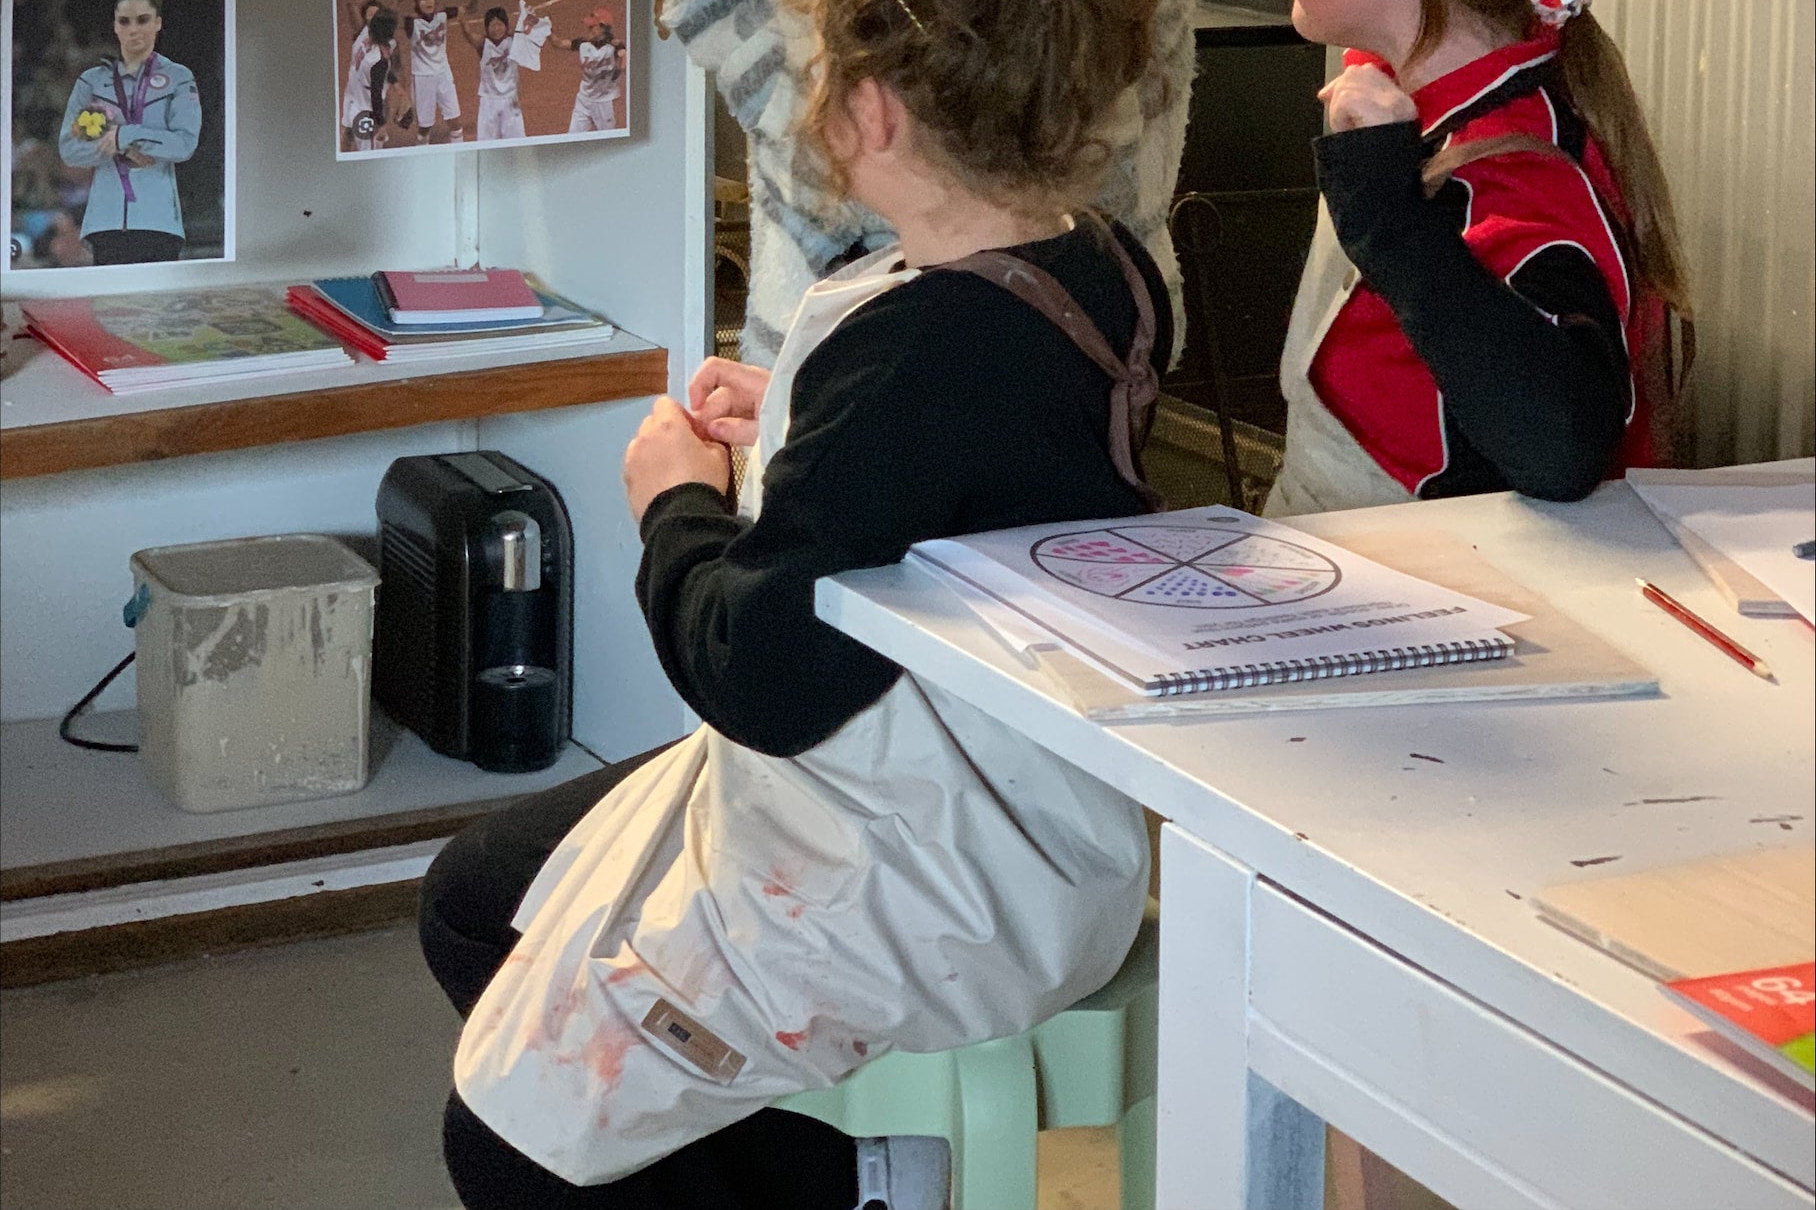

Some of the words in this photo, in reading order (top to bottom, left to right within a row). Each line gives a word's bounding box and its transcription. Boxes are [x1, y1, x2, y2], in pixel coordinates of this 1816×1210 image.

[1352, 606, 1468, 629] FEELINGS
[1266, 623, 1350, 640] WHEEL
[1184, 634, 1267, 651] CHART
